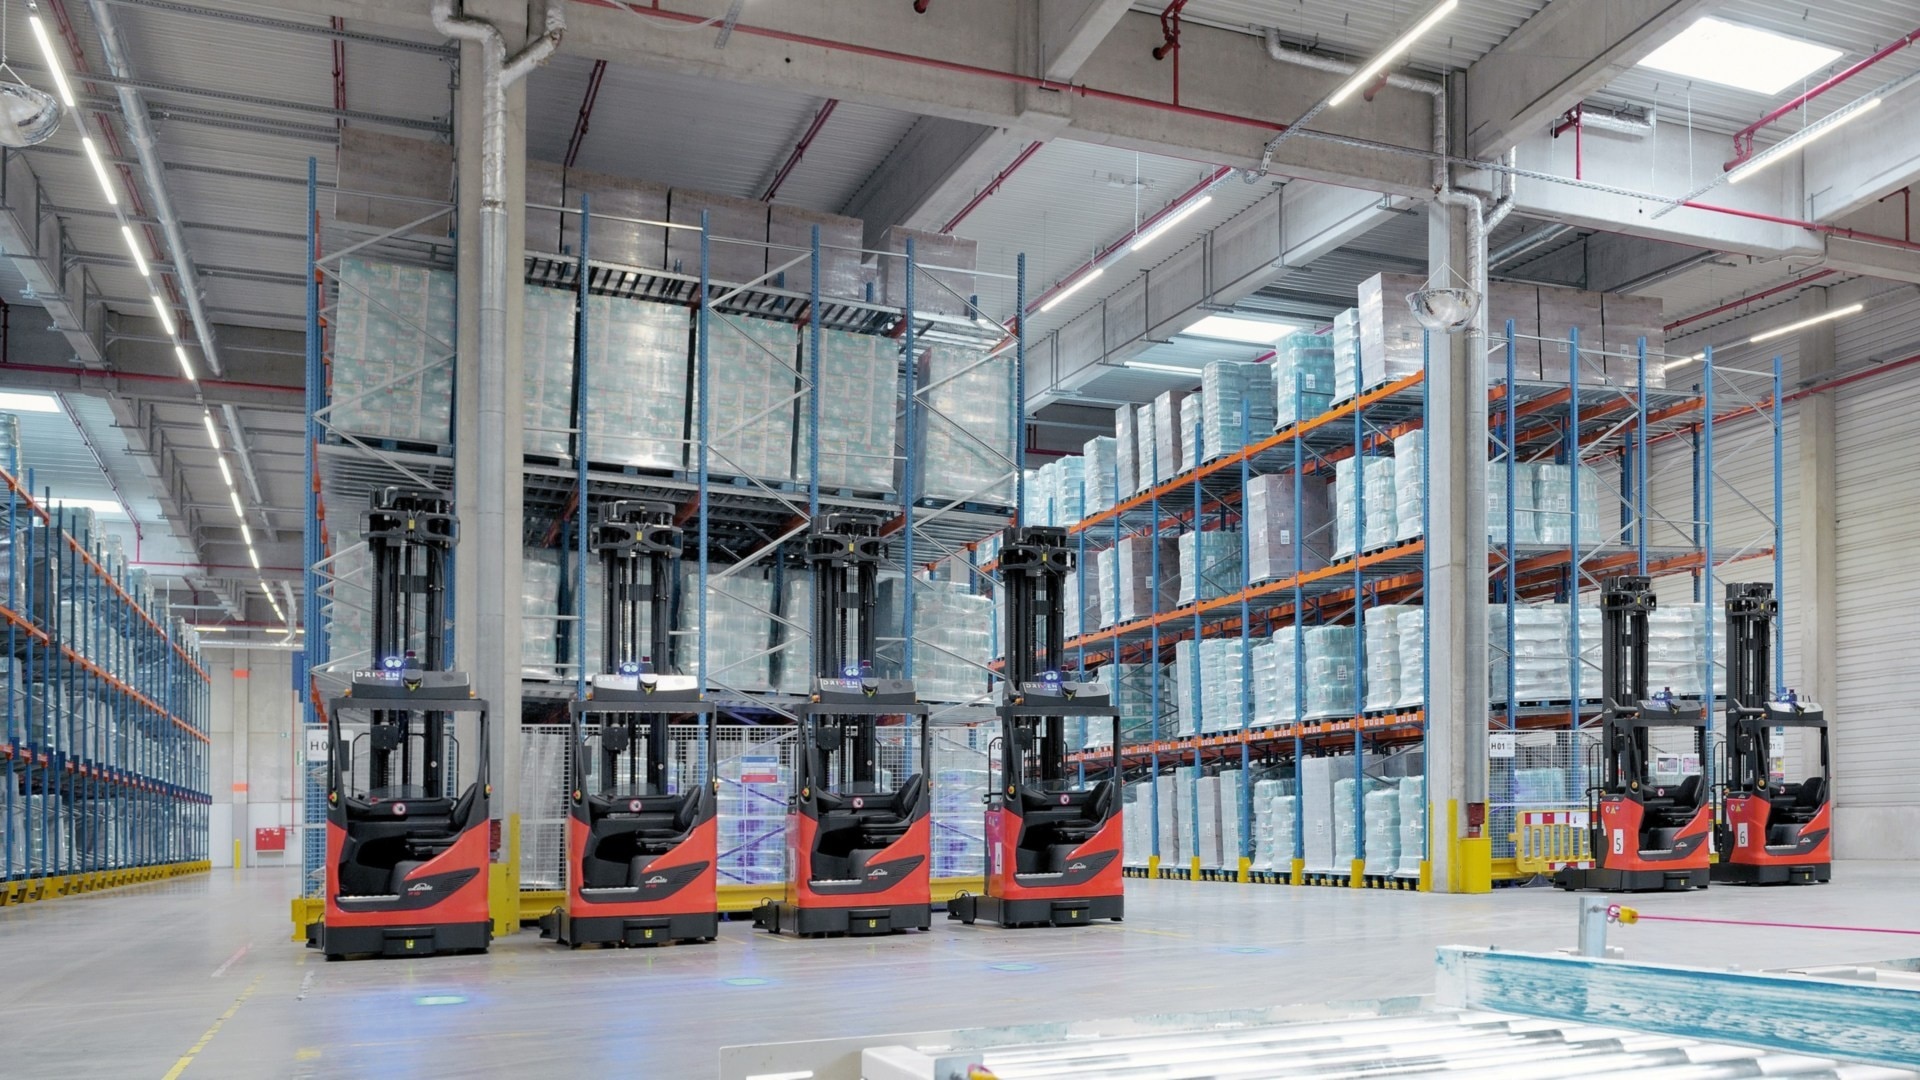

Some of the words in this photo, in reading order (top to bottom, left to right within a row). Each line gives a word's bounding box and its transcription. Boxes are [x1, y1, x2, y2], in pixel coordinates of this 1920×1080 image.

[310, 741, 329, 750] H0
[1740, 831, 1746, 844] 6
[1615, 838, 1621, 851] 5
